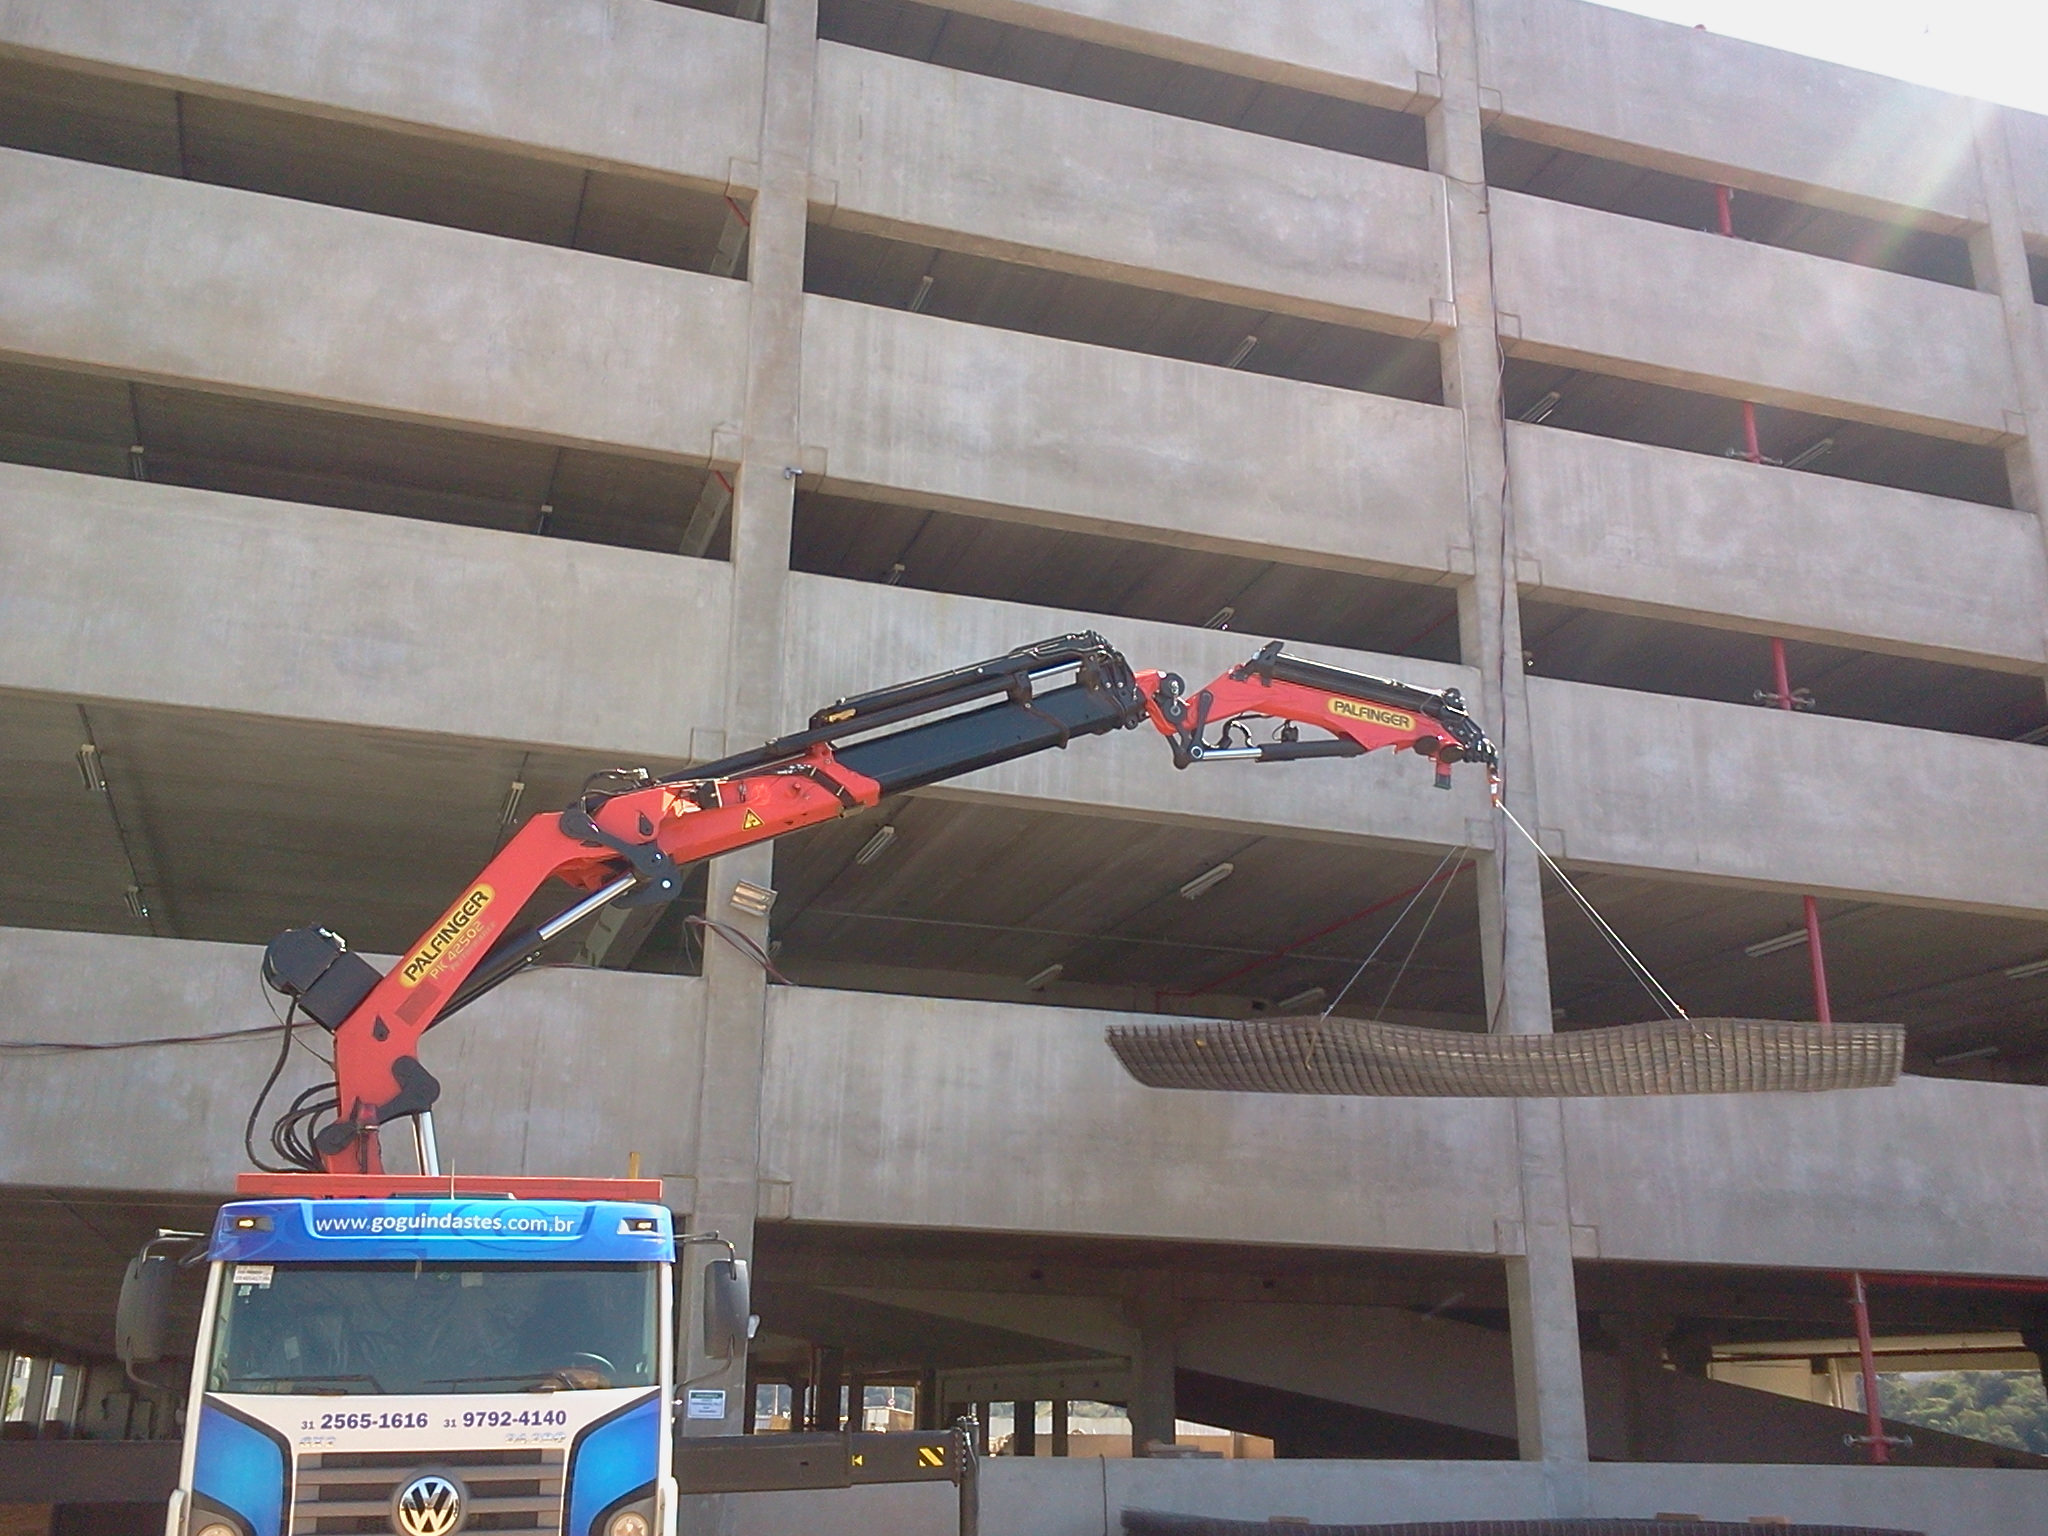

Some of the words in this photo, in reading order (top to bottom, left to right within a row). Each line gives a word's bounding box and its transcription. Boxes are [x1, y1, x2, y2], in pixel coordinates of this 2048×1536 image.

[1334, 701, 1410, 728] PALFINGER
[403, 890, 490, 982] PALFINGER
[429, 960, 449, 980] PK
[446, 921, 485, 961] 42502
[315, 1212, 575, 1233] www.goguindastes.com.br
[300, 1420, 315, 1430] 31
[320, 1412, 429, 1430] 2565-1616
[443, 1418, 458, 1429] 31
[462, 1410, 567, 1428] 9792-4140
[399, 1475, 460, 1536] VW
